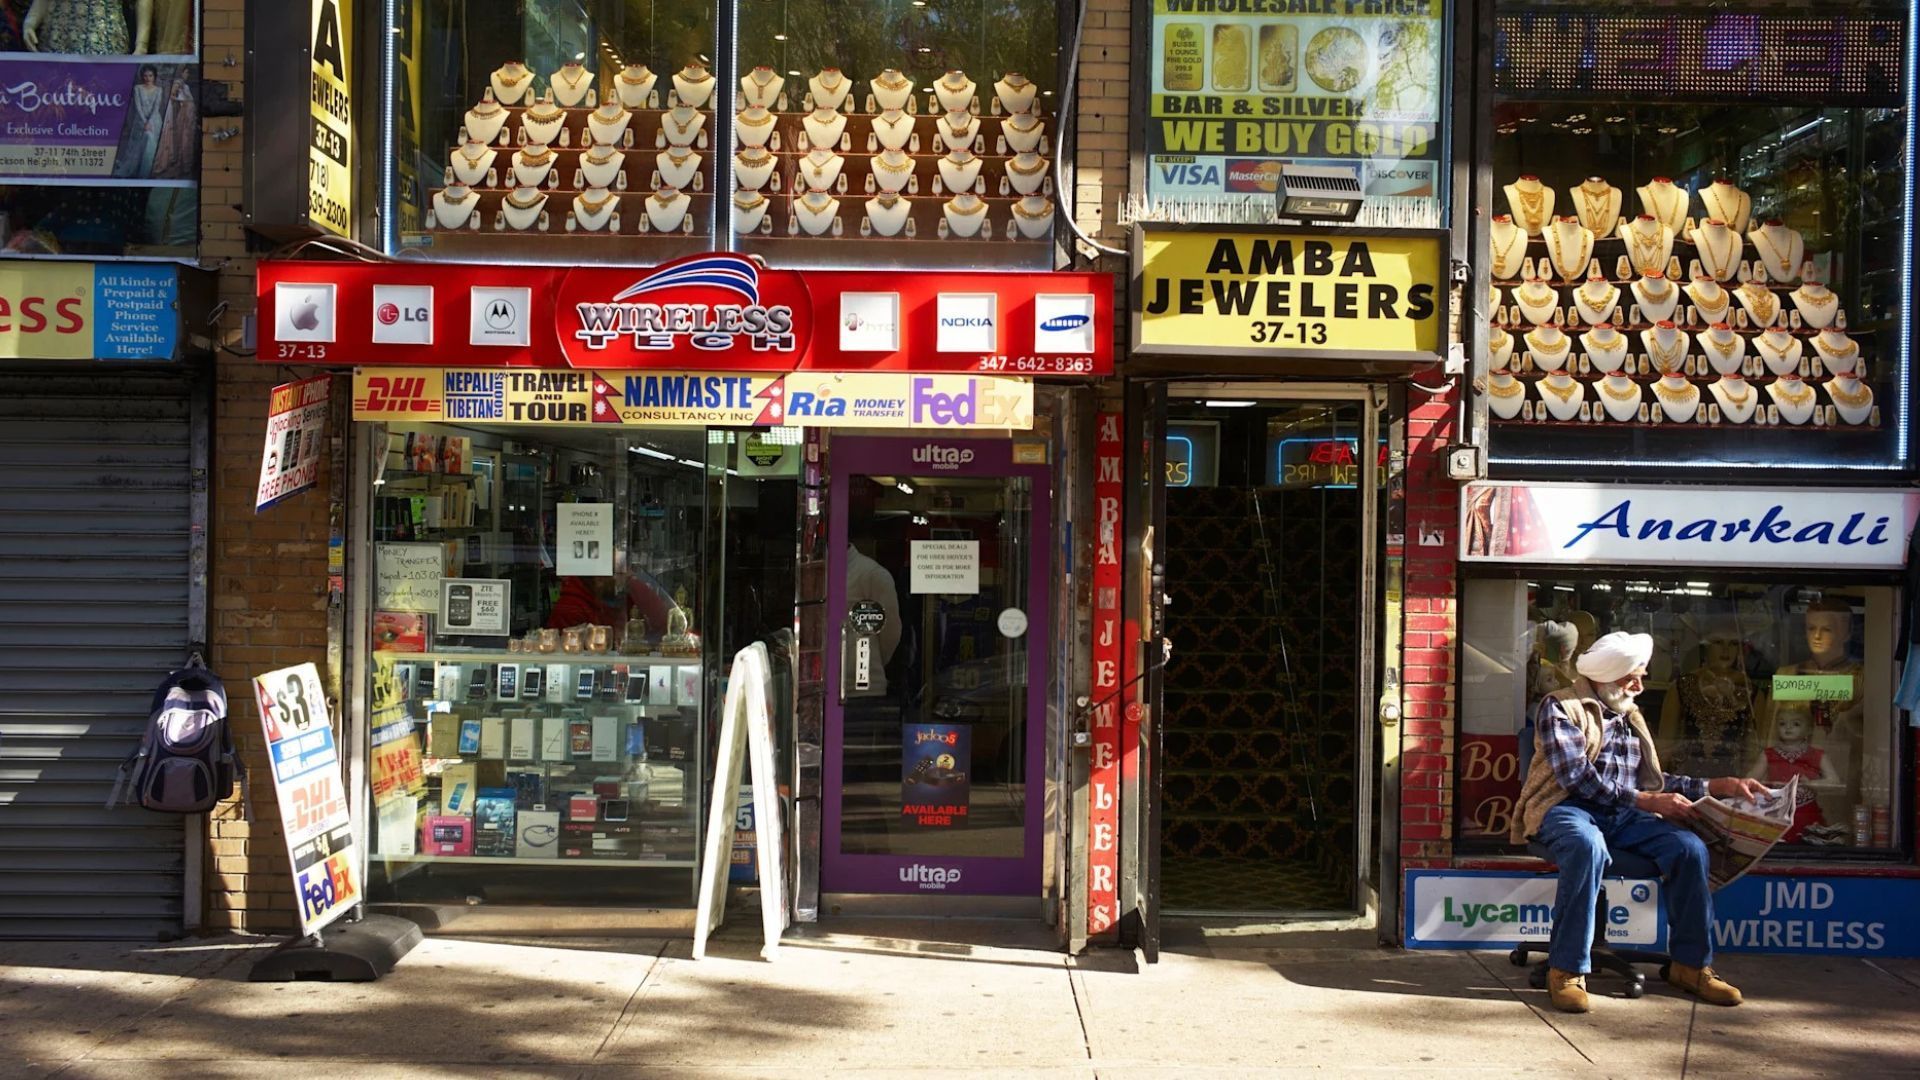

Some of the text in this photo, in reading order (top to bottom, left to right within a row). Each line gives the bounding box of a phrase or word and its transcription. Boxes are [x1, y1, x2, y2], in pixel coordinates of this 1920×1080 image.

[1166, 0, 1432, 15] WHOLESALE PRICE
[1183, 56, 1202, 64] GOLD
[6, 81, 125, 115] Boutique
[1163, 95, 1223, 115] BAR
[1232, 96, 1254, 115] &
[1262, 96, 1366, 117] SILVER
[7, 122, 109, 136] Exclusive Collection
[314, 123, 341, 159] 37-13
[1162, 121, 1428, 157] WE BUY GOLD
[34, 147, 107, 158] 37-11 74th Street
[64, 157, 76, 167] NY
[79, 157, 104, 167] 11372
[1156, 164, 1220, 186] VISA
[1228, 171, 1279, 182] MasterCa
[1369, 169, 1430, 181] DISCOVER
[1205, 238, 1377, 278] AMBA
[98, 277, 174, 287] All kinds of
[103, 288, 168, 300] Prepaid &
[1146, 278, 1435, 320] JEWELERS
[107, 299, 164, 311] Postpaid
[114, 311, 156, 321] Phone
[404, 307, 429, 323] LG
[576, 302, 793, 334] WIRELESS
[941, 316, 994, 329] NOKIA
[1045, 318, 1085, 328] SAMSUNG
[111, 322, 160, 332] Service
[1250, 321, 1328, 345] 37-13
[104, 333, 165, 343] Available
[575, 331, 797, 352] TECH
[116, 344, 154, 354] Here!
[277, 344, 326, 358] 37-13
[978, 356, 1094, 372] 347-642-8363
[445, 371, 494, 392] NEPALI
[509, 372, 588, 393] TRAVEL
[366, 376, 431, 412] DHL
[494, 372, 504, 418] GOODS
[534, 393, 563, 401] AND
[624, 375, 752, 409] NAMASTE
[445, 398, 493, 419] TIBETAN
[787, 386, 847, 417] Ria
[854, 398, 905, 409] MONEY
[509, 402, 587, 422] TOUR
[622, 410, 754, 422] CONSULTANCY INC
[853, 408, 905, 418] TRANSFER
[912, 443, 960, 464] ultra
[1562, 499, 1890, 549] Anarkali
[378, 546, 408, 560] MONEY
[477, 599, 500, 607] FREE
[857, 613, 884, 625] primo
[859, 640, 868, 680] PULL
[1774, 680, 1820, 692] BOMBAY
[1815, 689, 1850, 701] BAZAR
[1460, 740, 1521, 782] Bo
[1091, 619, 1116, 932] JEWELERS
[292, 777, 340, 832] DHL
[902, 804, 968, 816] AVAILABLE
[917, 815, 952, 826] HERE
[899, 864, 947, 883] ultra
[299, 853, 355, 921] FedEx
[919, 881, 946, 890] mobile
[1759, 880, 1835, 916] JMD
[1443, 896, 1630, 927] Lycame
[1519, 925, 1630, 937] Call th less
[1714, 919, 1885, 951] WIRELESS
